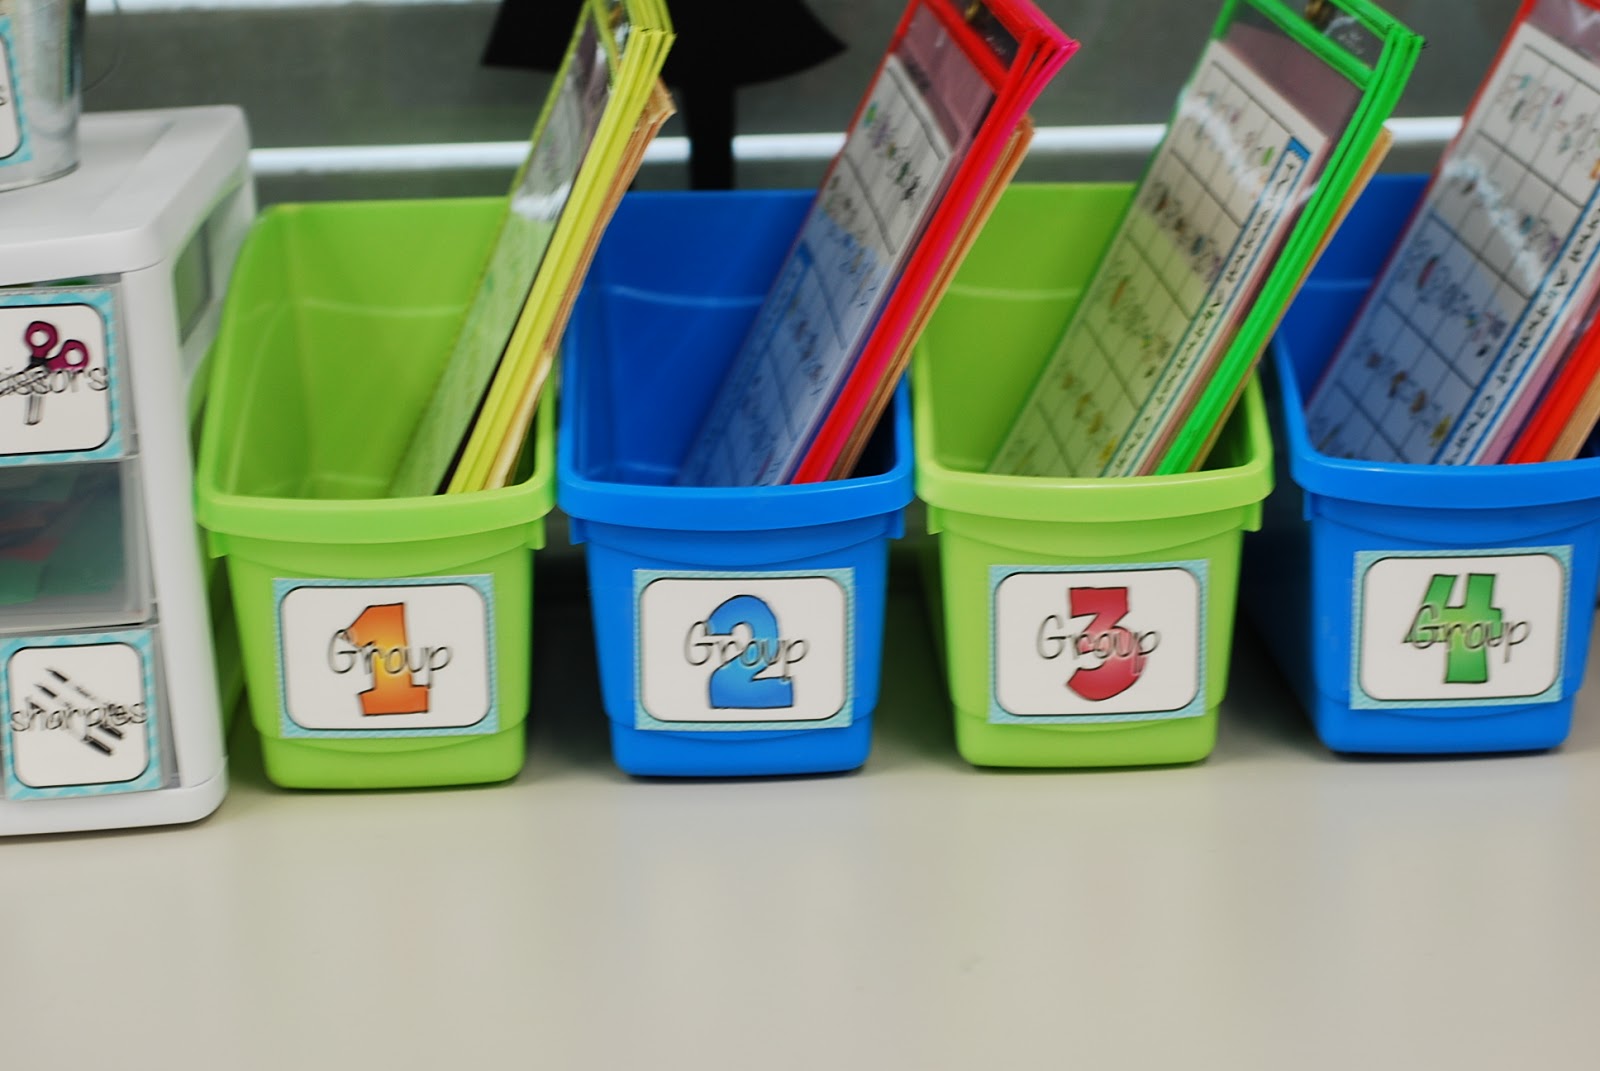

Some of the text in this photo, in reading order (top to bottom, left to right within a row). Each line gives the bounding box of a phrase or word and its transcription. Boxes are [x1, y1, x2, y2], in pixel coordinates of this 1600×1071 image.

[328, 629, 452, 688] Group
[346, 602, 430, 716] 1
[684, 621, 810, 682] Group
[708, 594, 794, 710] 2
[1036, 614, 1161, 675] Group
[1066, 586, 1147, 702] 3
[1402, 573, 1503, 685] 4
[1411, 603, 1531, 664] Group
